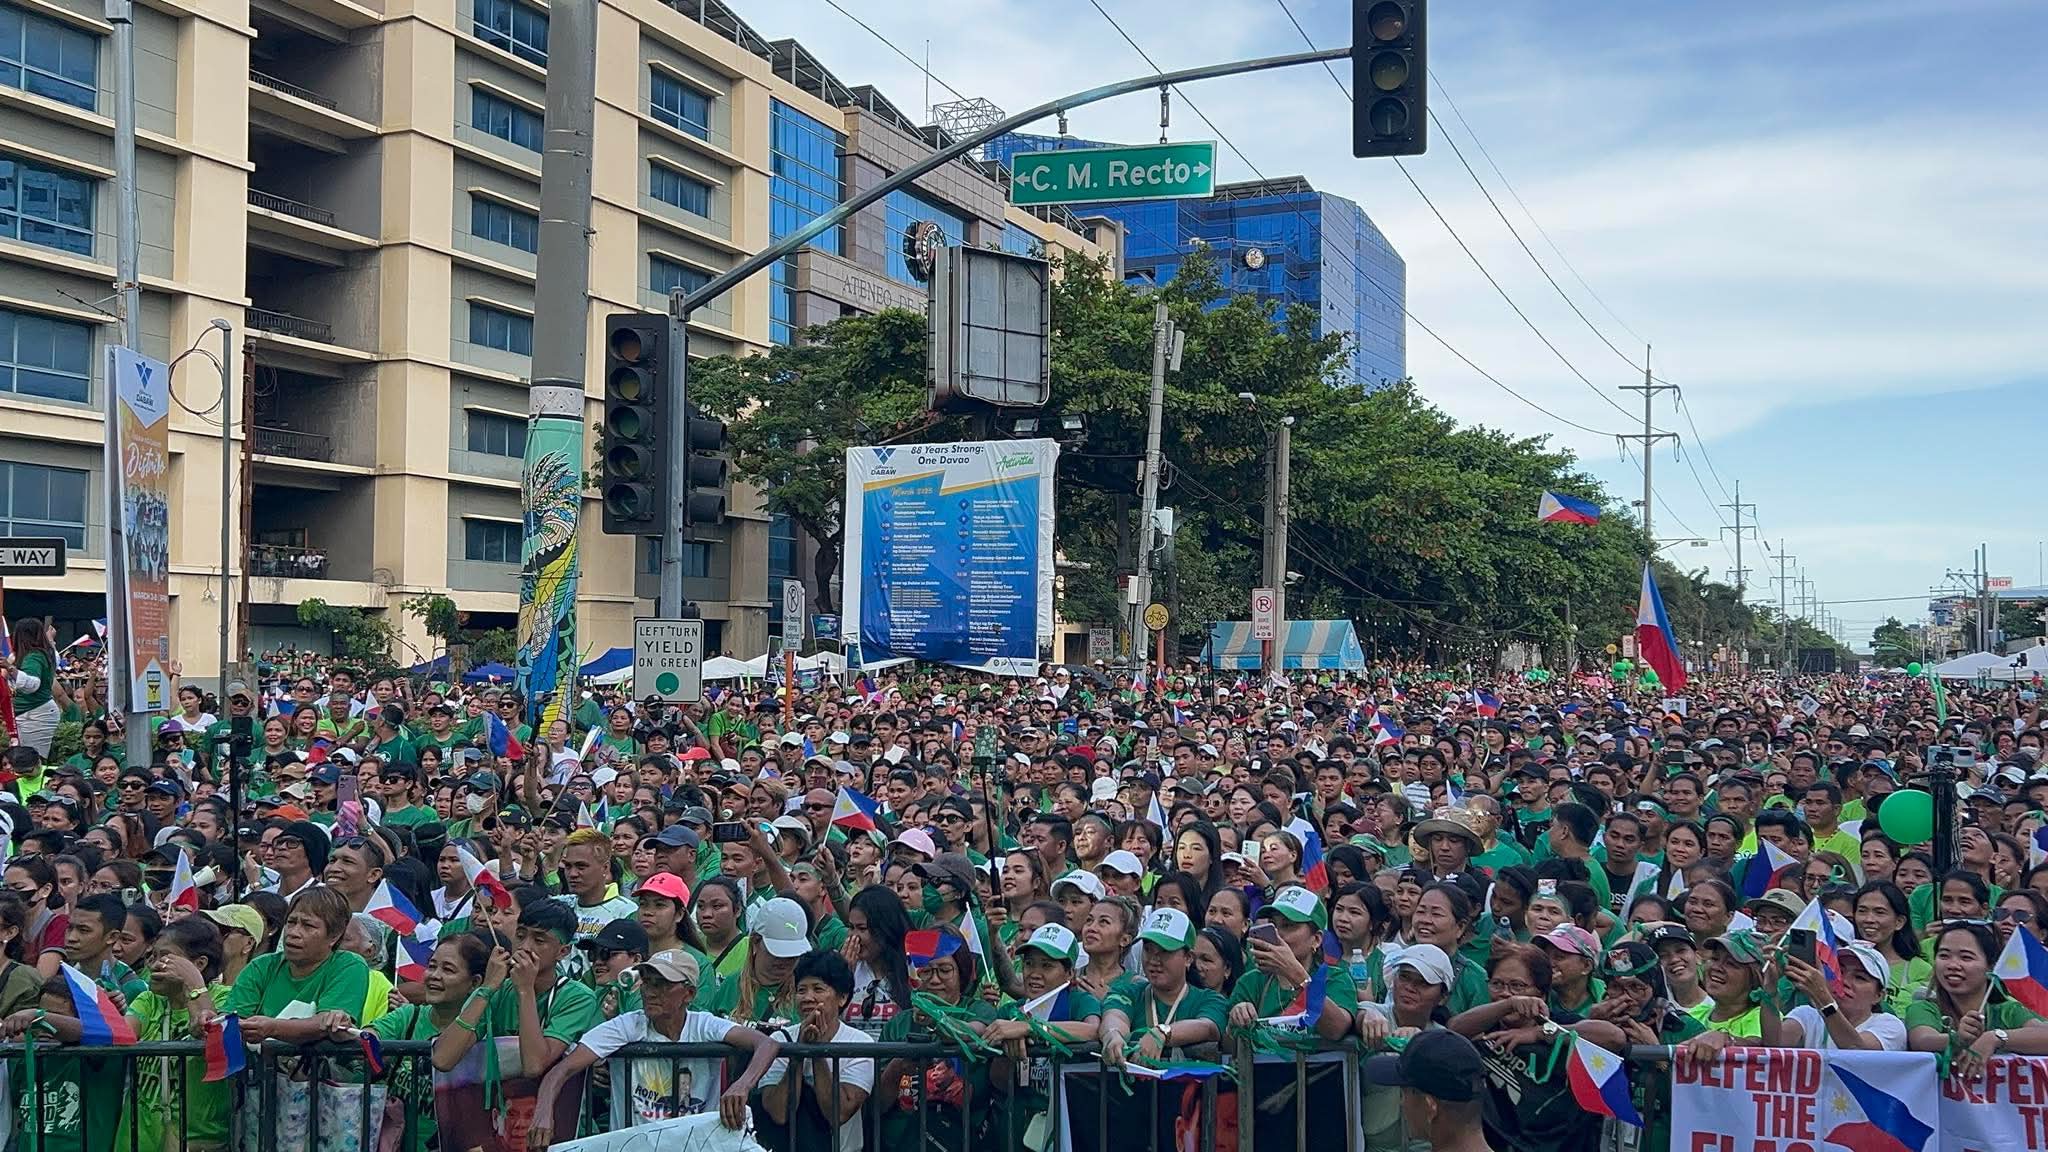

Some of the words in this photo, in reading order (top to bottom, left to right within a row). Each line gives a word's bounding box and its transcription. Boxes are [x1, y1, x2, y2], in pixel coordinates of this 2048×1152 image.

[1032, 165, 1058, 191] C.
[1067, 162, 1098, 189] M.
[1108, 157, 1191, 187] Recto
[842, 274, 892, 307] ATENEO
[911, 446, 922, 454] 88
[925, 446, 949, 454] Years
[951, 444, 984, 455] Strong:
[918, 456, 937, 465] One
[939, 457, 970, 465] Davao
[13, 550, 50, 564] WAY
[639, 626, 665, 636] LEFT
[669, 626, 698, 636] TURN
[644, 641, 693, 654] YIELD
[639, 658, 653, 667] ON
[661, 657, 698, 668] GREEN
[1676, 1047, 1821, 1095] DEFEND
[634, 1083, 660, 1101] RODY
[1752, 1093, 1816, 1140] THE
[2018, 1107, 2048, 1150] T
